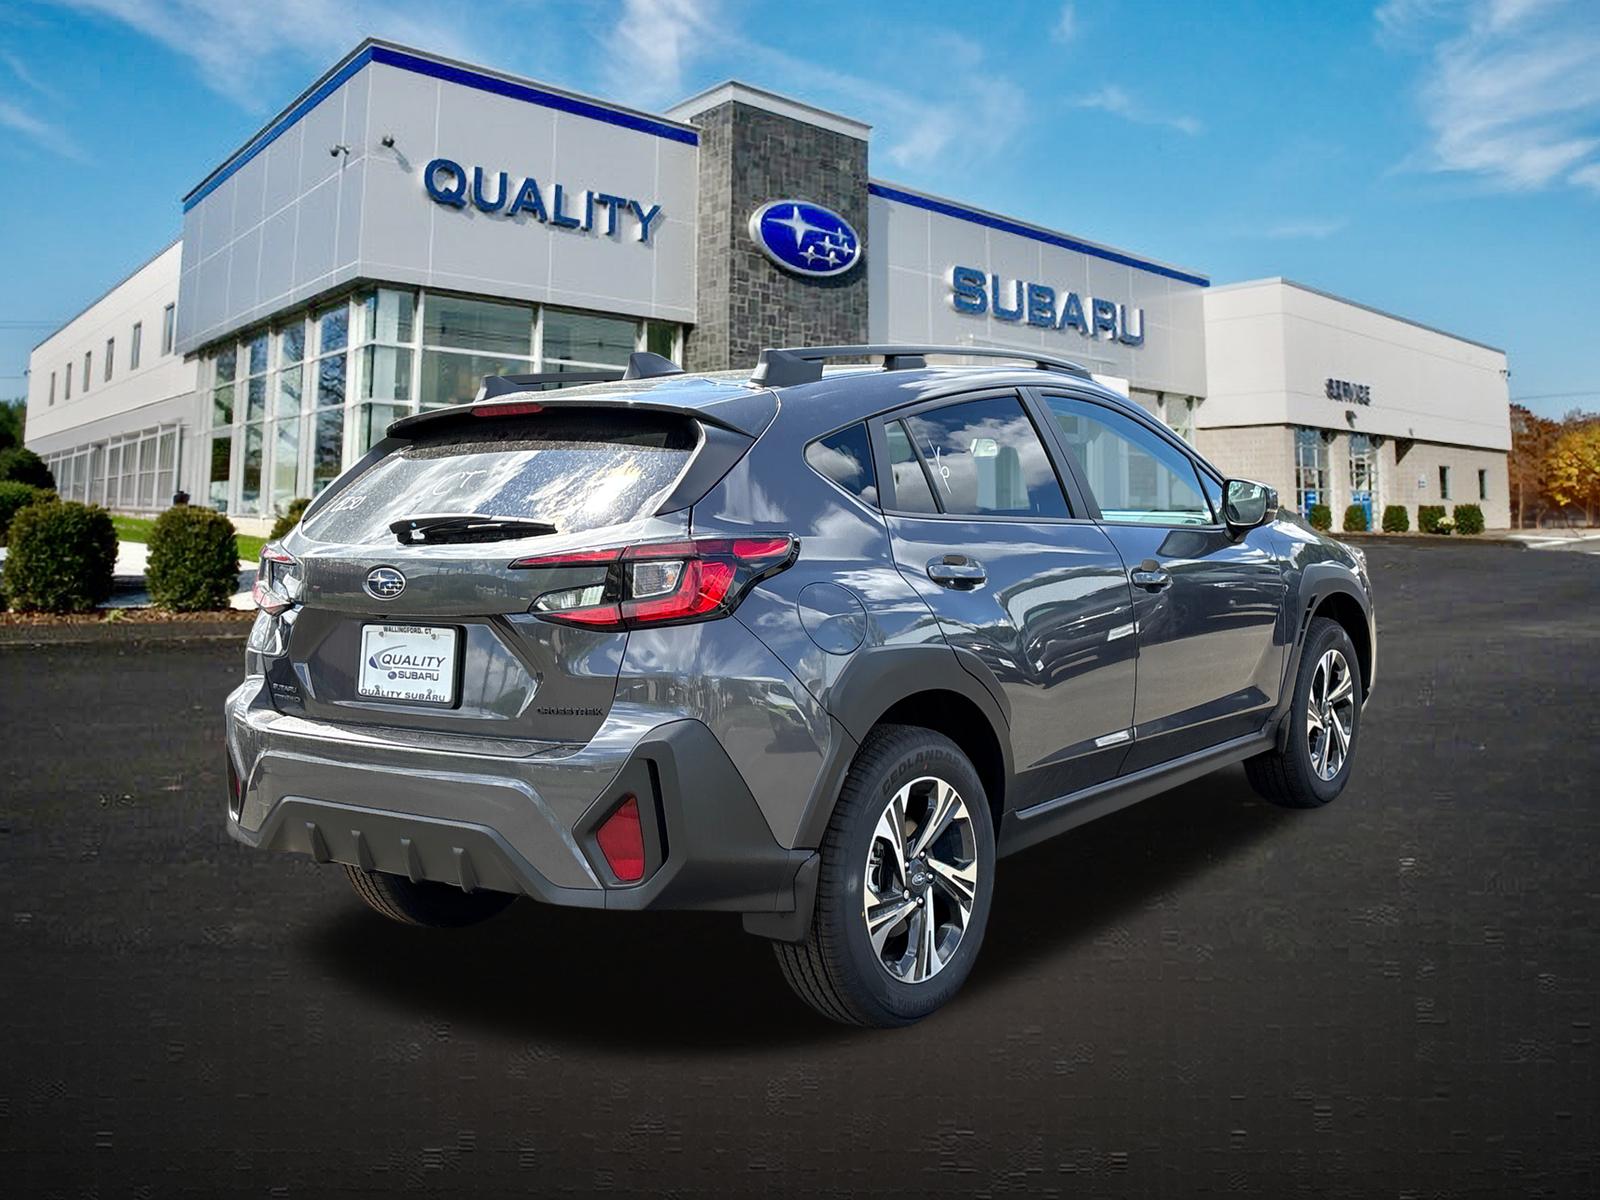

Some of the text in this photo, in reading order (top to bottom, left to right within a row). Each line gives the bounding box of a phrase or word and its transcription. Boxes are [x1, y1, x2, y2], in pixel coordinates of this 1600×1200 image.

[423, 157, 662, 243] QUALITY
[948, 264, 1145, 347] SUBARU
[1324, 377, 1371, 406] SERVICE
[381, 653, 446, 668] QUALITY
[398, 671, 439, 681] SUBARU
[360, 688, 446, 702] QUALITY SUBARU
[536, 706, 604, 717] CROSSTREK
